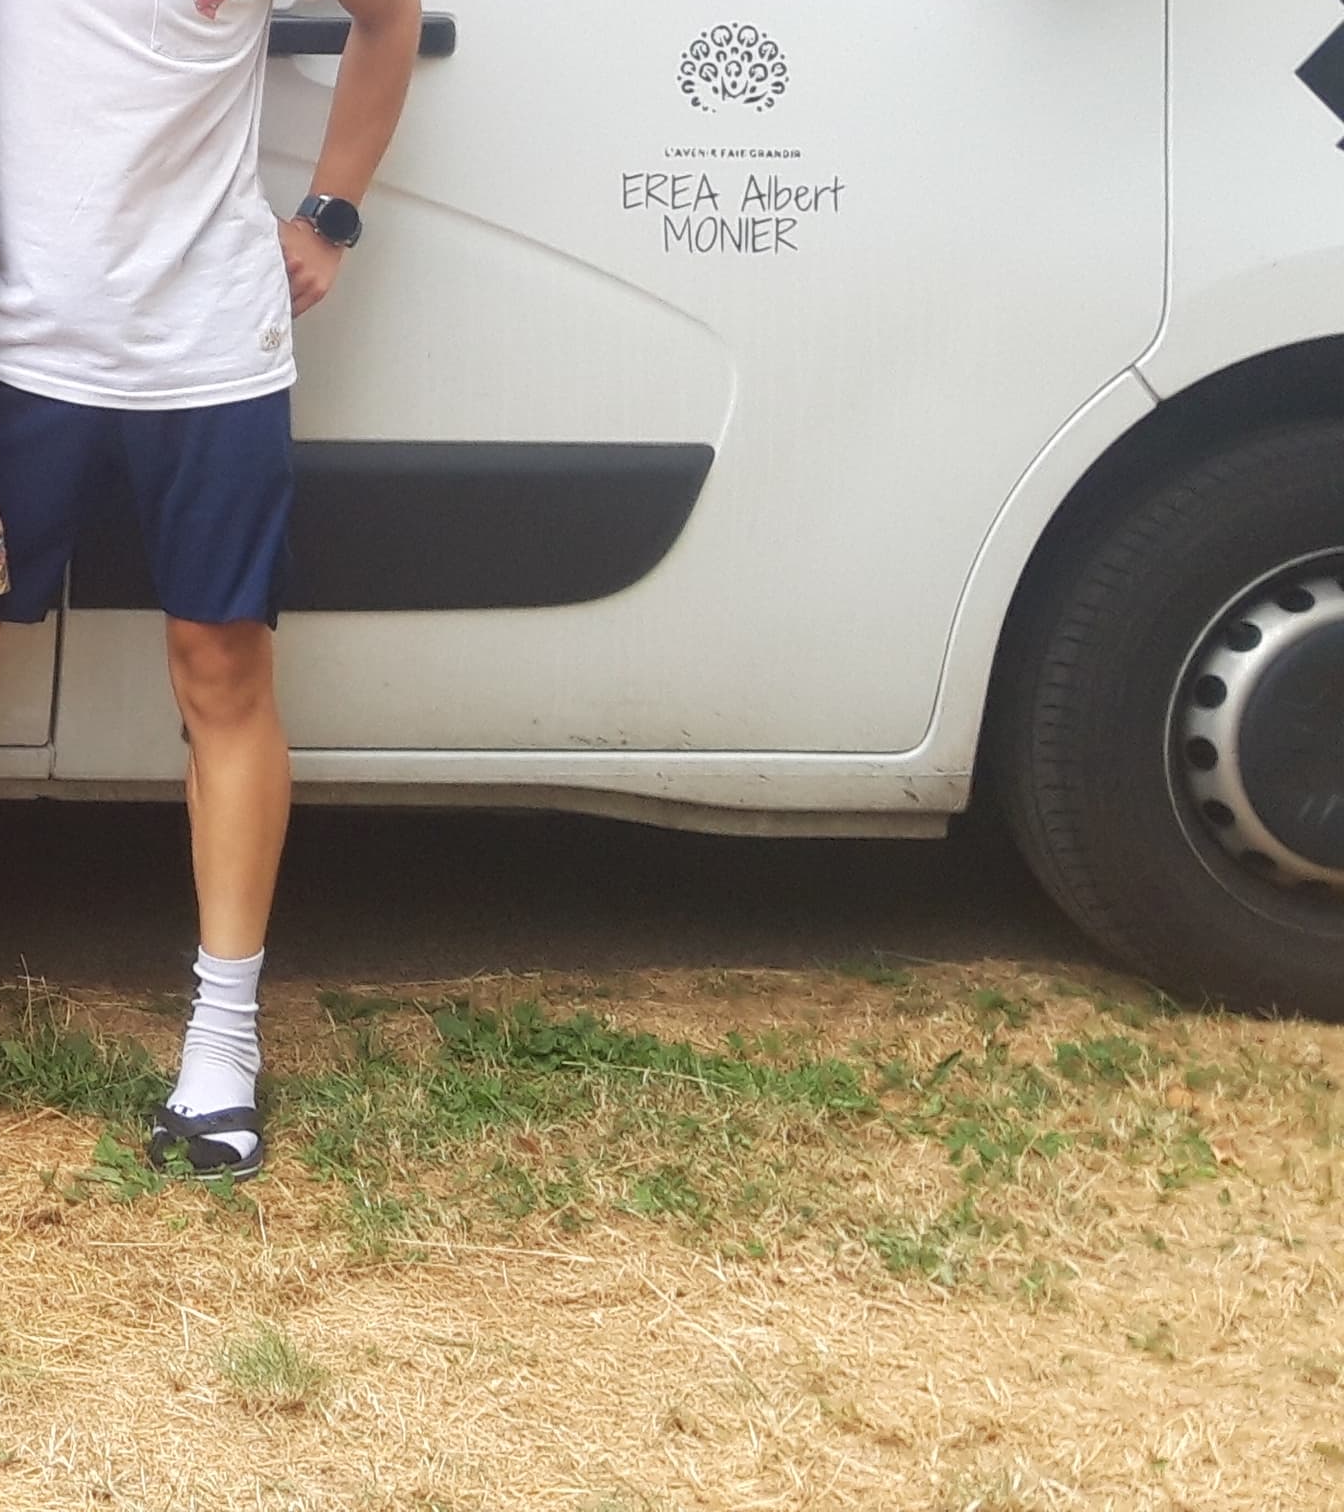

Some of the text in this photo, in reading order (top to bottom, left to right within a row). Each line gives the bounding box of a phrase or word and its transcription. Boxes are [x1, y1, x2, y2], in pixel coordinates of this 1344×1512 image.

[622, 172, 846, 213] EREA Albert
[663, 214, 799, 255] MONIER
